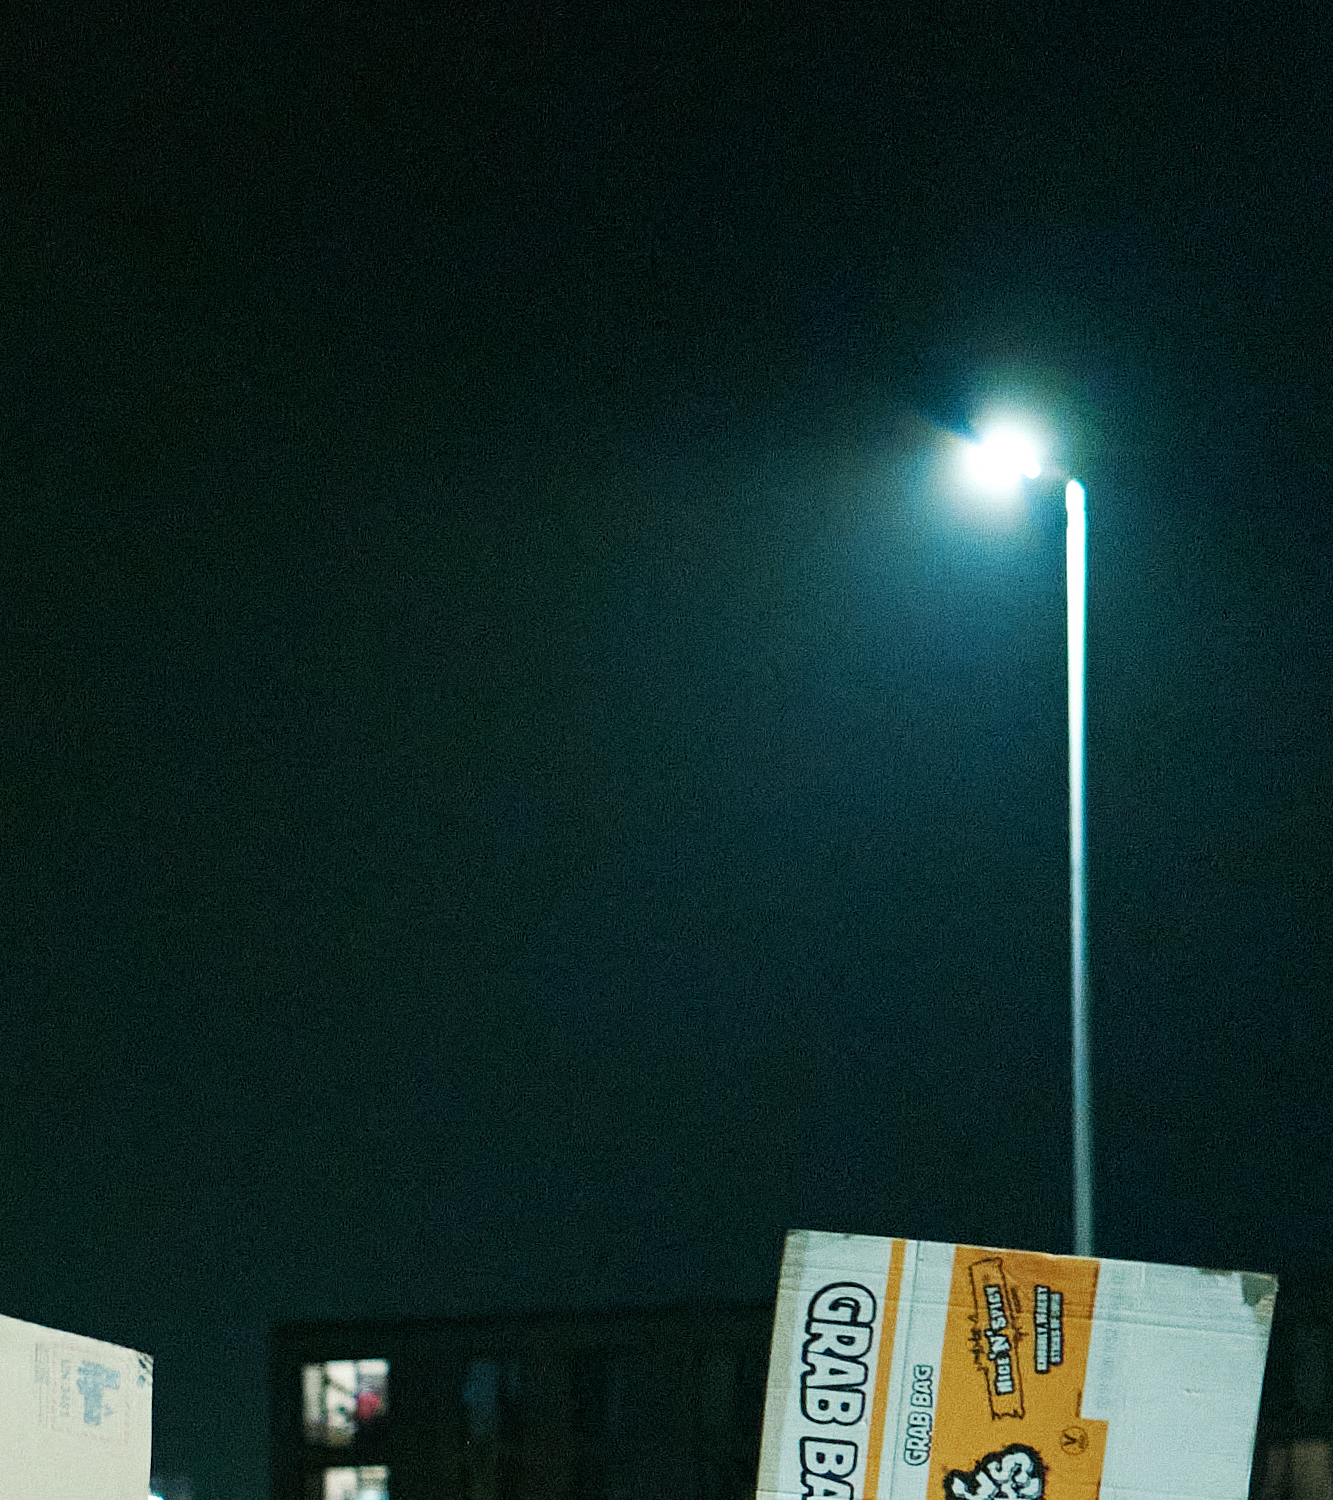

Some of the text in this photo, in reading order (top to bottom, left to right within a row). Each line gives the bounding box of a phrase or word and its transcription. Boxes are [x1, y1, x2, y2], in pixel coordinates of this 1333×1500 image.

[984, 1286, 1007, 1331] SPICY
[799, 1281, 877, 1426] GRAB
[995, 1357, 1014, 1394] NICE
[904, 1365, 933, 1466] GRAB BAG
